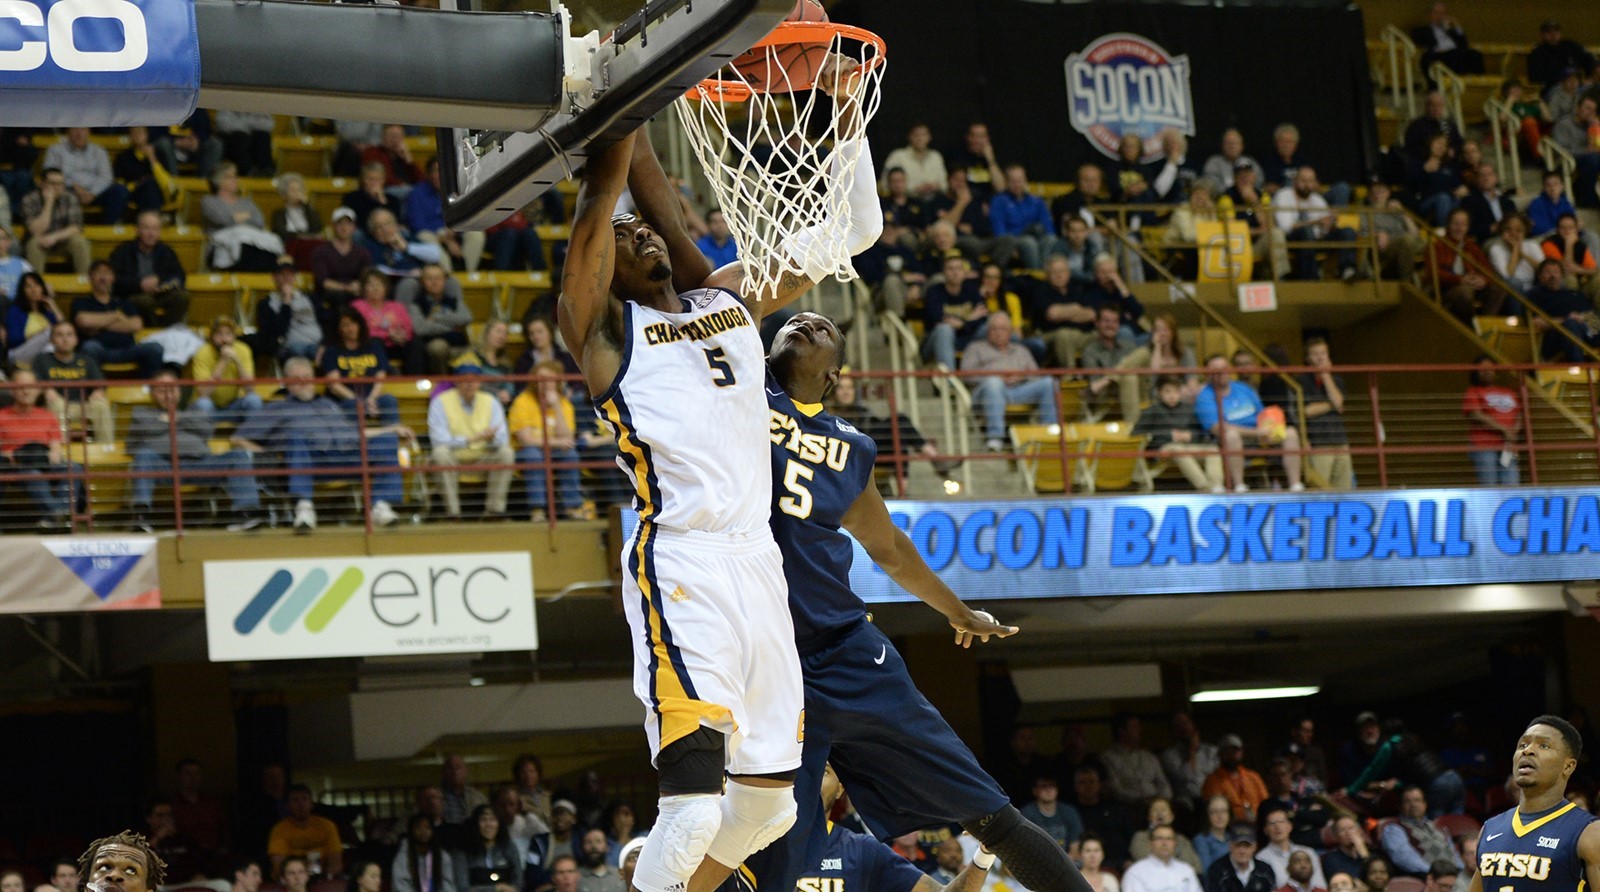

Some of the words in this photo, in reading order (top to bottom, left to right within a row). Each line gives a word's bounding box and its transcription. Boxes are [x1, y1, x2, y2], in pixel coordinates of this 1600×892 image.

[1072, 61, 1187, 124] SOCON
[643, 306, 750, 346] CHATANOOGA
[702, 345, 737, 388] 5
[769, 408, 851, 473] ETSU
[778, 458, 814, 520] 5
[69, 541, 129, 555] SECTION
[1109, 498, 1474, 568] BASKETBALL
[1492, 495, 1600, 556] CHA
[92, 557, 113, 570] 109
[370, 566, 510, 628] erc
[1480, 852, 1552, 881] ETSU
